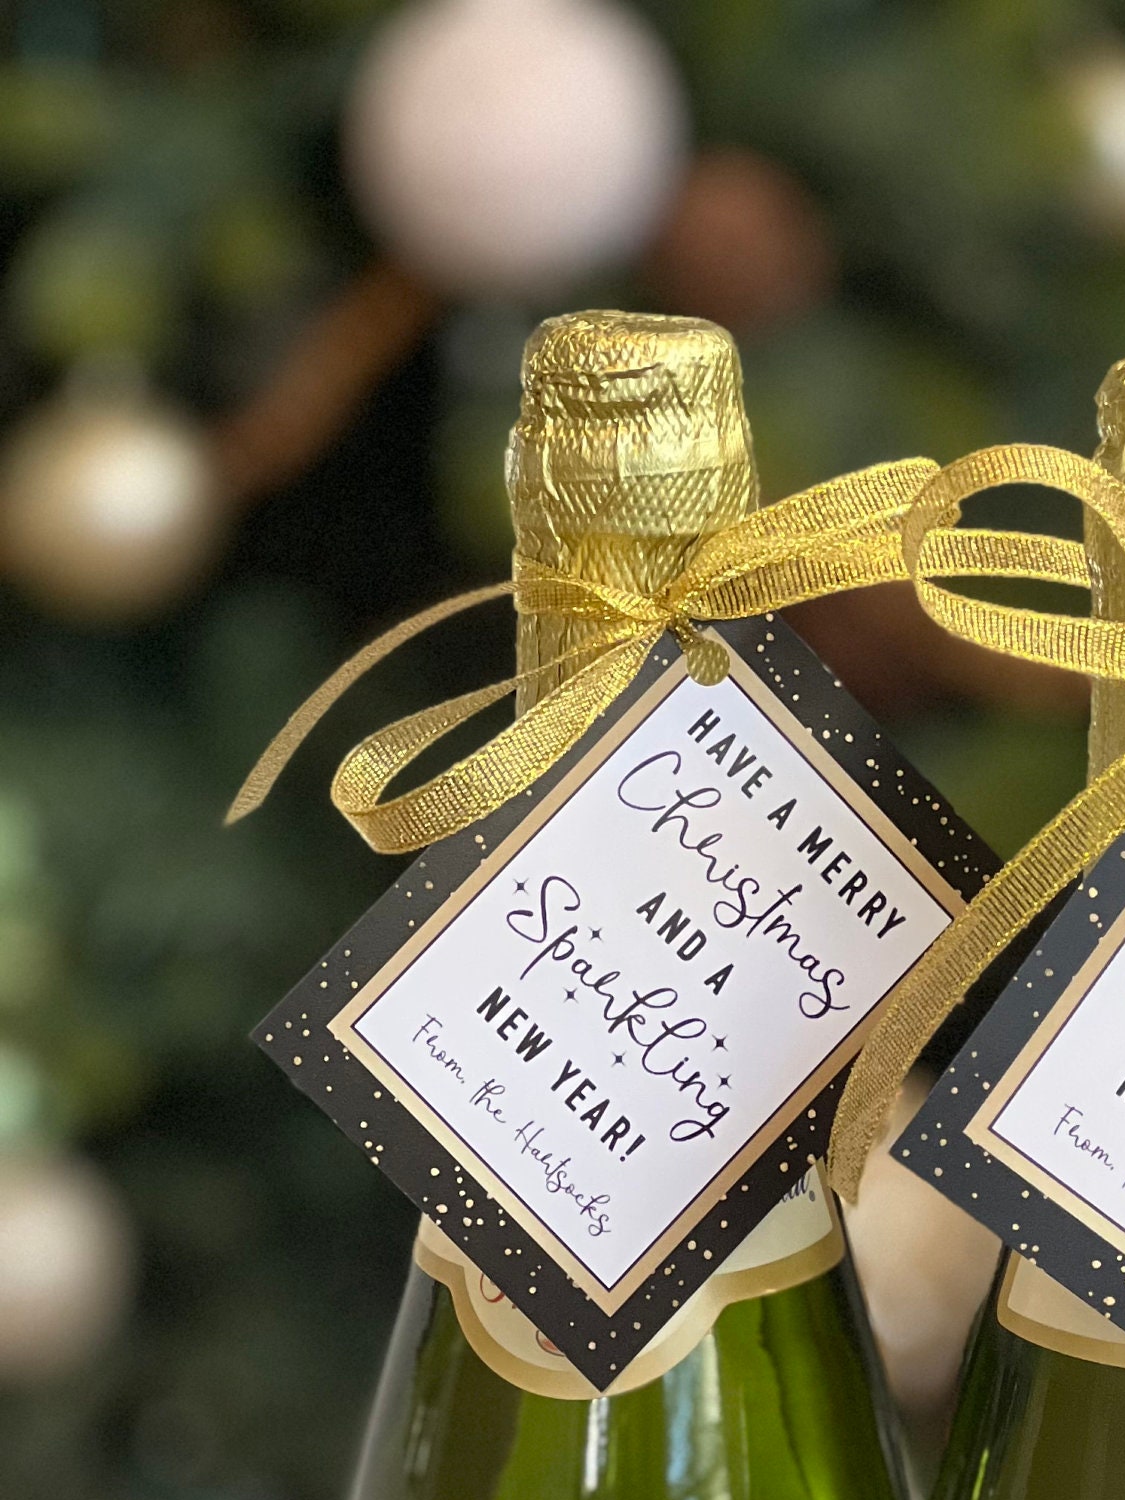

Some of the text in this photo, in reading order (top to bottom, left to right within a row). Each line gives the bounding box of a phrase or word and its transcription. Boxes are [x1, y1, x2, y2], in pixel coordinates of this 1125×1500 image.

[618, 751, 849, 1019] Christmas
[688, 709, 906, 939] HAVE A MERRY
[507, 876, 730, 1142] Sparkling
[638, 892, 734, 995] AND A
[469, 1078, 507, 1124] the
[514, 1120, 611, 1237] Hartsocks
[478, 987, 646, 1163] NEW YEAR!
